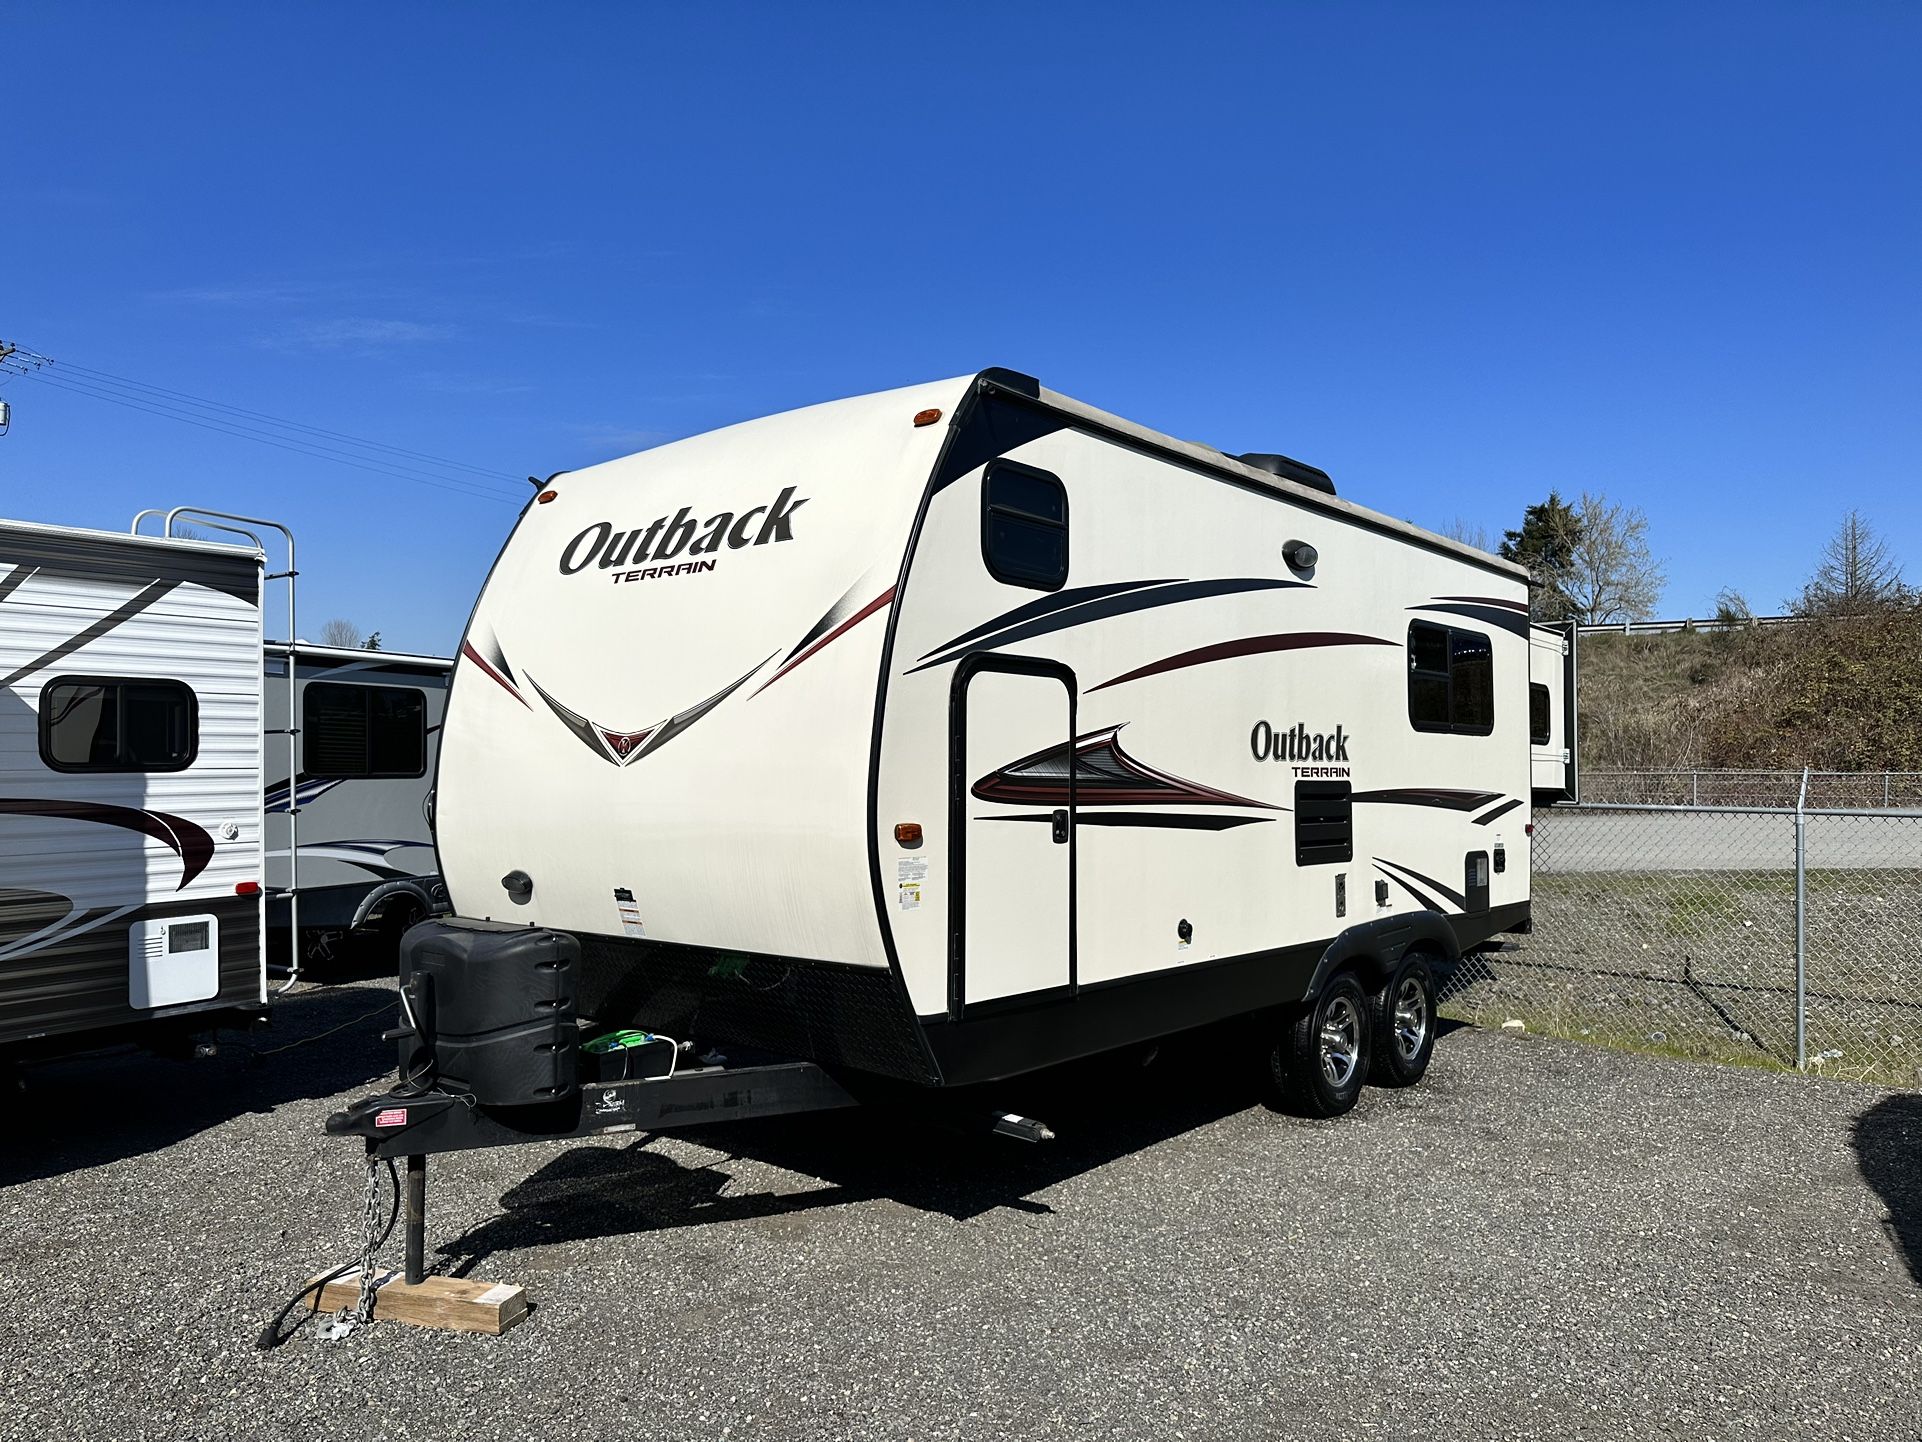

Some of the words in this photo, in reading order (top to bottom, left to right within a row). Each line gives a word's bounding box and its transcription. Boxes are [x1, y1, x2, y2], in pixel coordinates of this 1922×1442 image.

[559, 486, 811, 575] Outback
[611, 559, 717, 584] TERRAIN
[1251, 720, 1350, 762] Outback
[1291, 767, 1350, 778] TERRAIN
